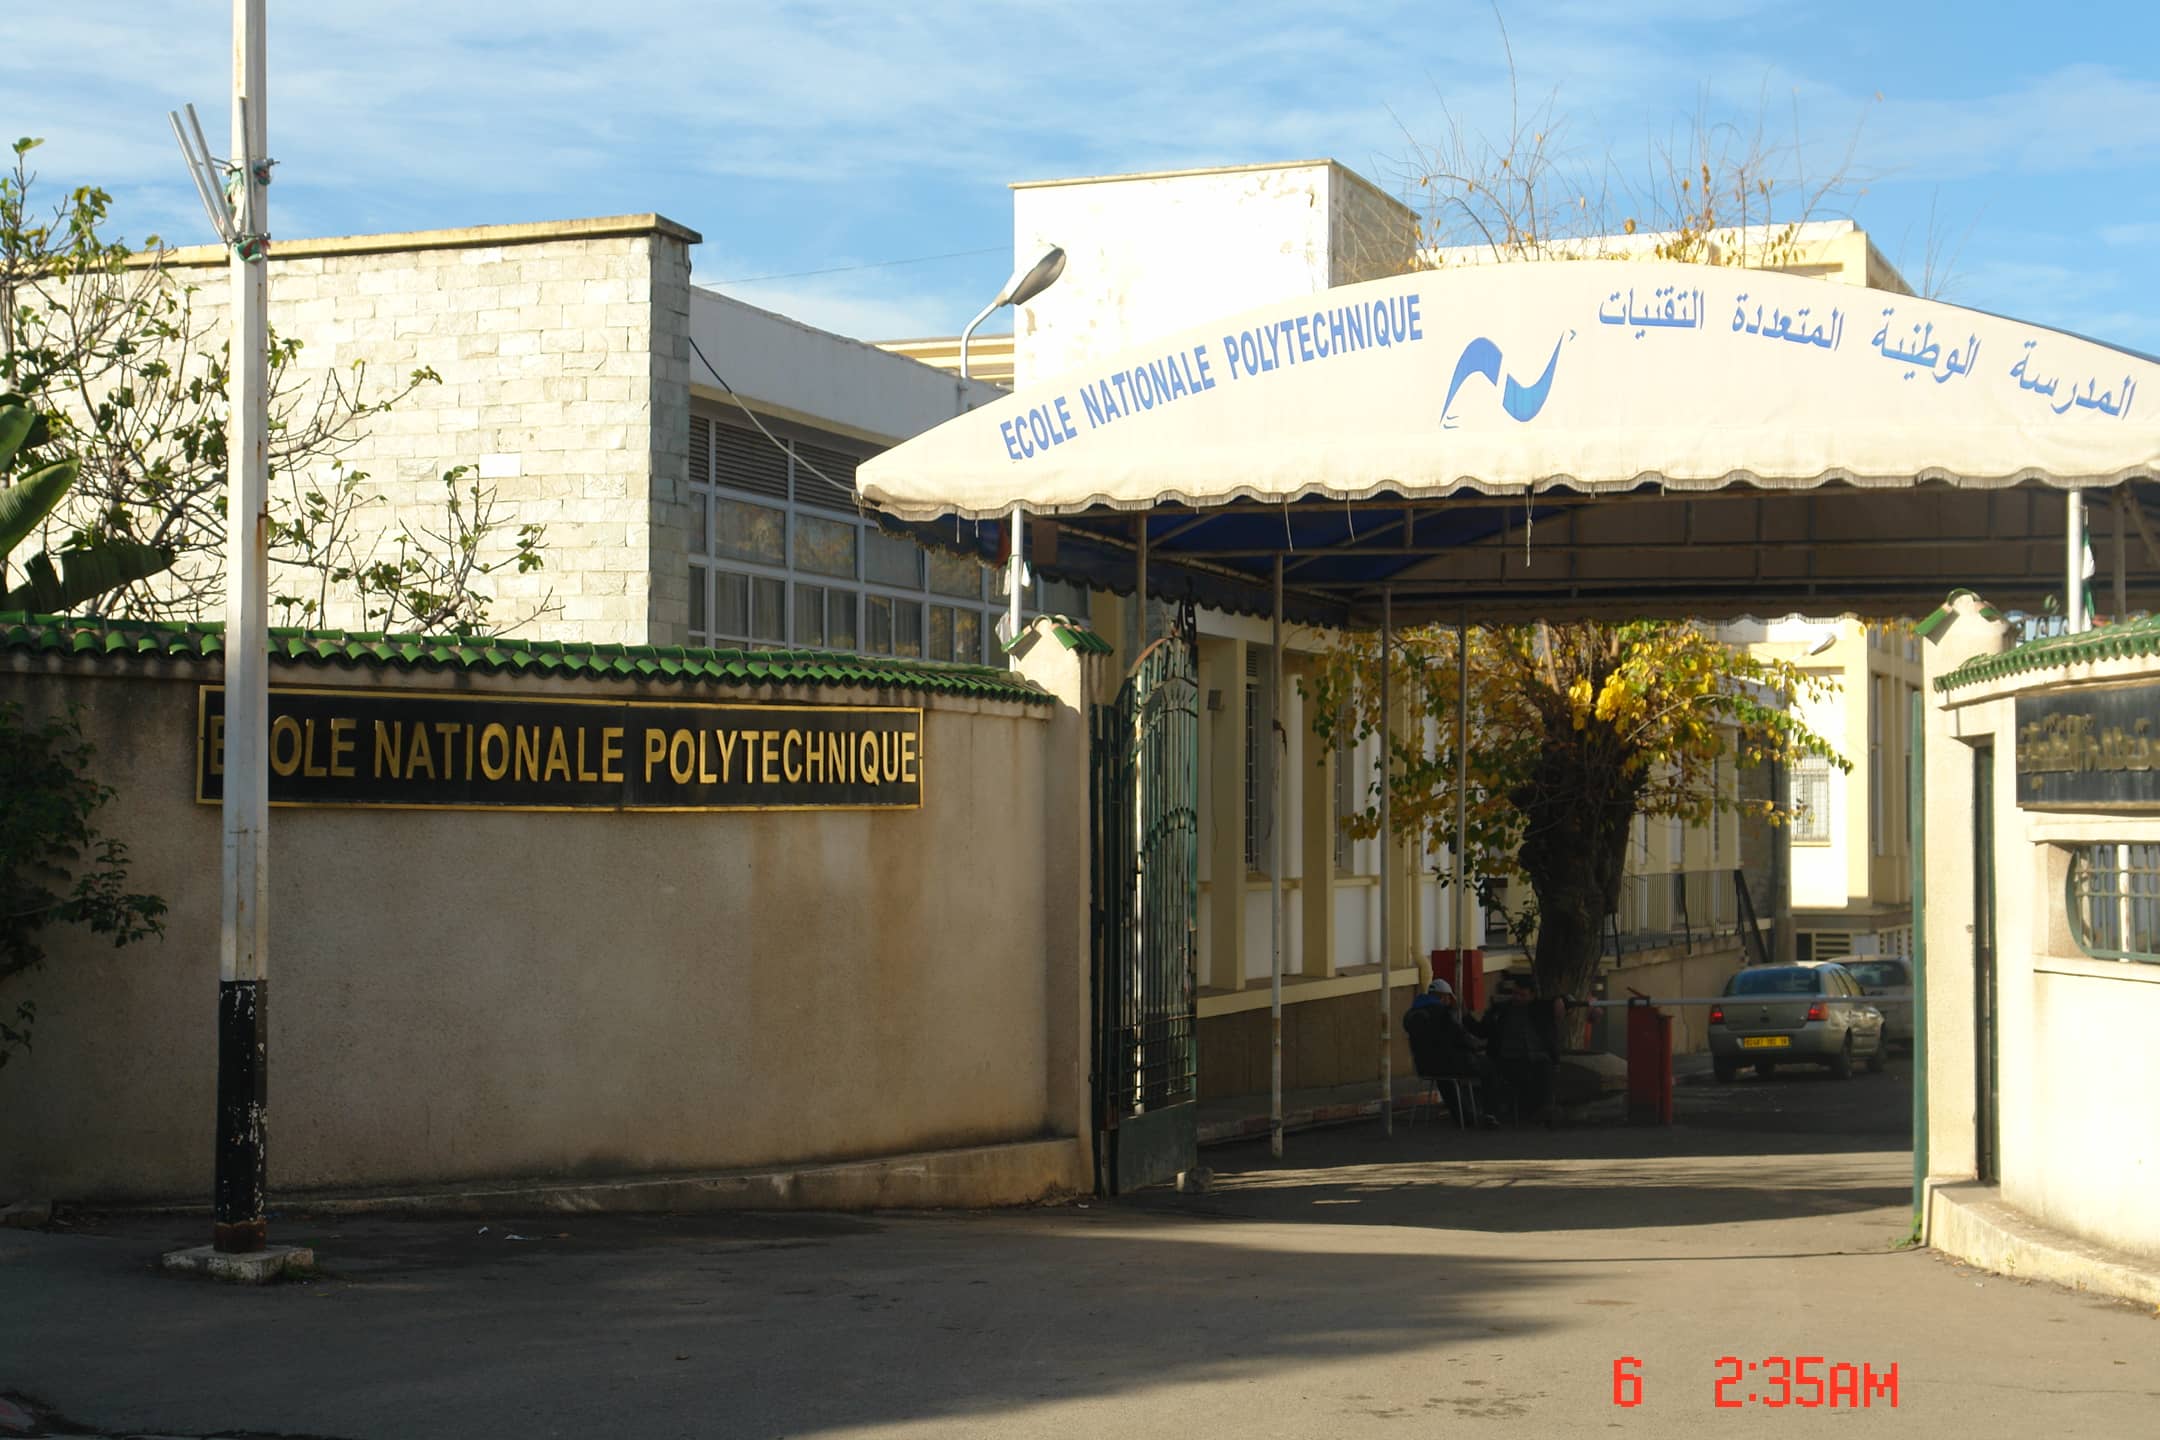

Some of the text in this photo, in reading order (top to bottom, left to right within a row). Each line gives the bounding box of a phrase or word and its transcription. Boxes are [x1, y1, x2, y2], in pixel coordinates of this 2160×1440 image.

[1000, 294, 1423, 460] ECOLE NATIONALE POLYTECHNIQUE
[1599, 286, 2136, 420] المدرسة الوطنية المتعددة التقنيات
[209, 715, 917, 786] EOLE NATIONALE POLYTECHNIQUE
